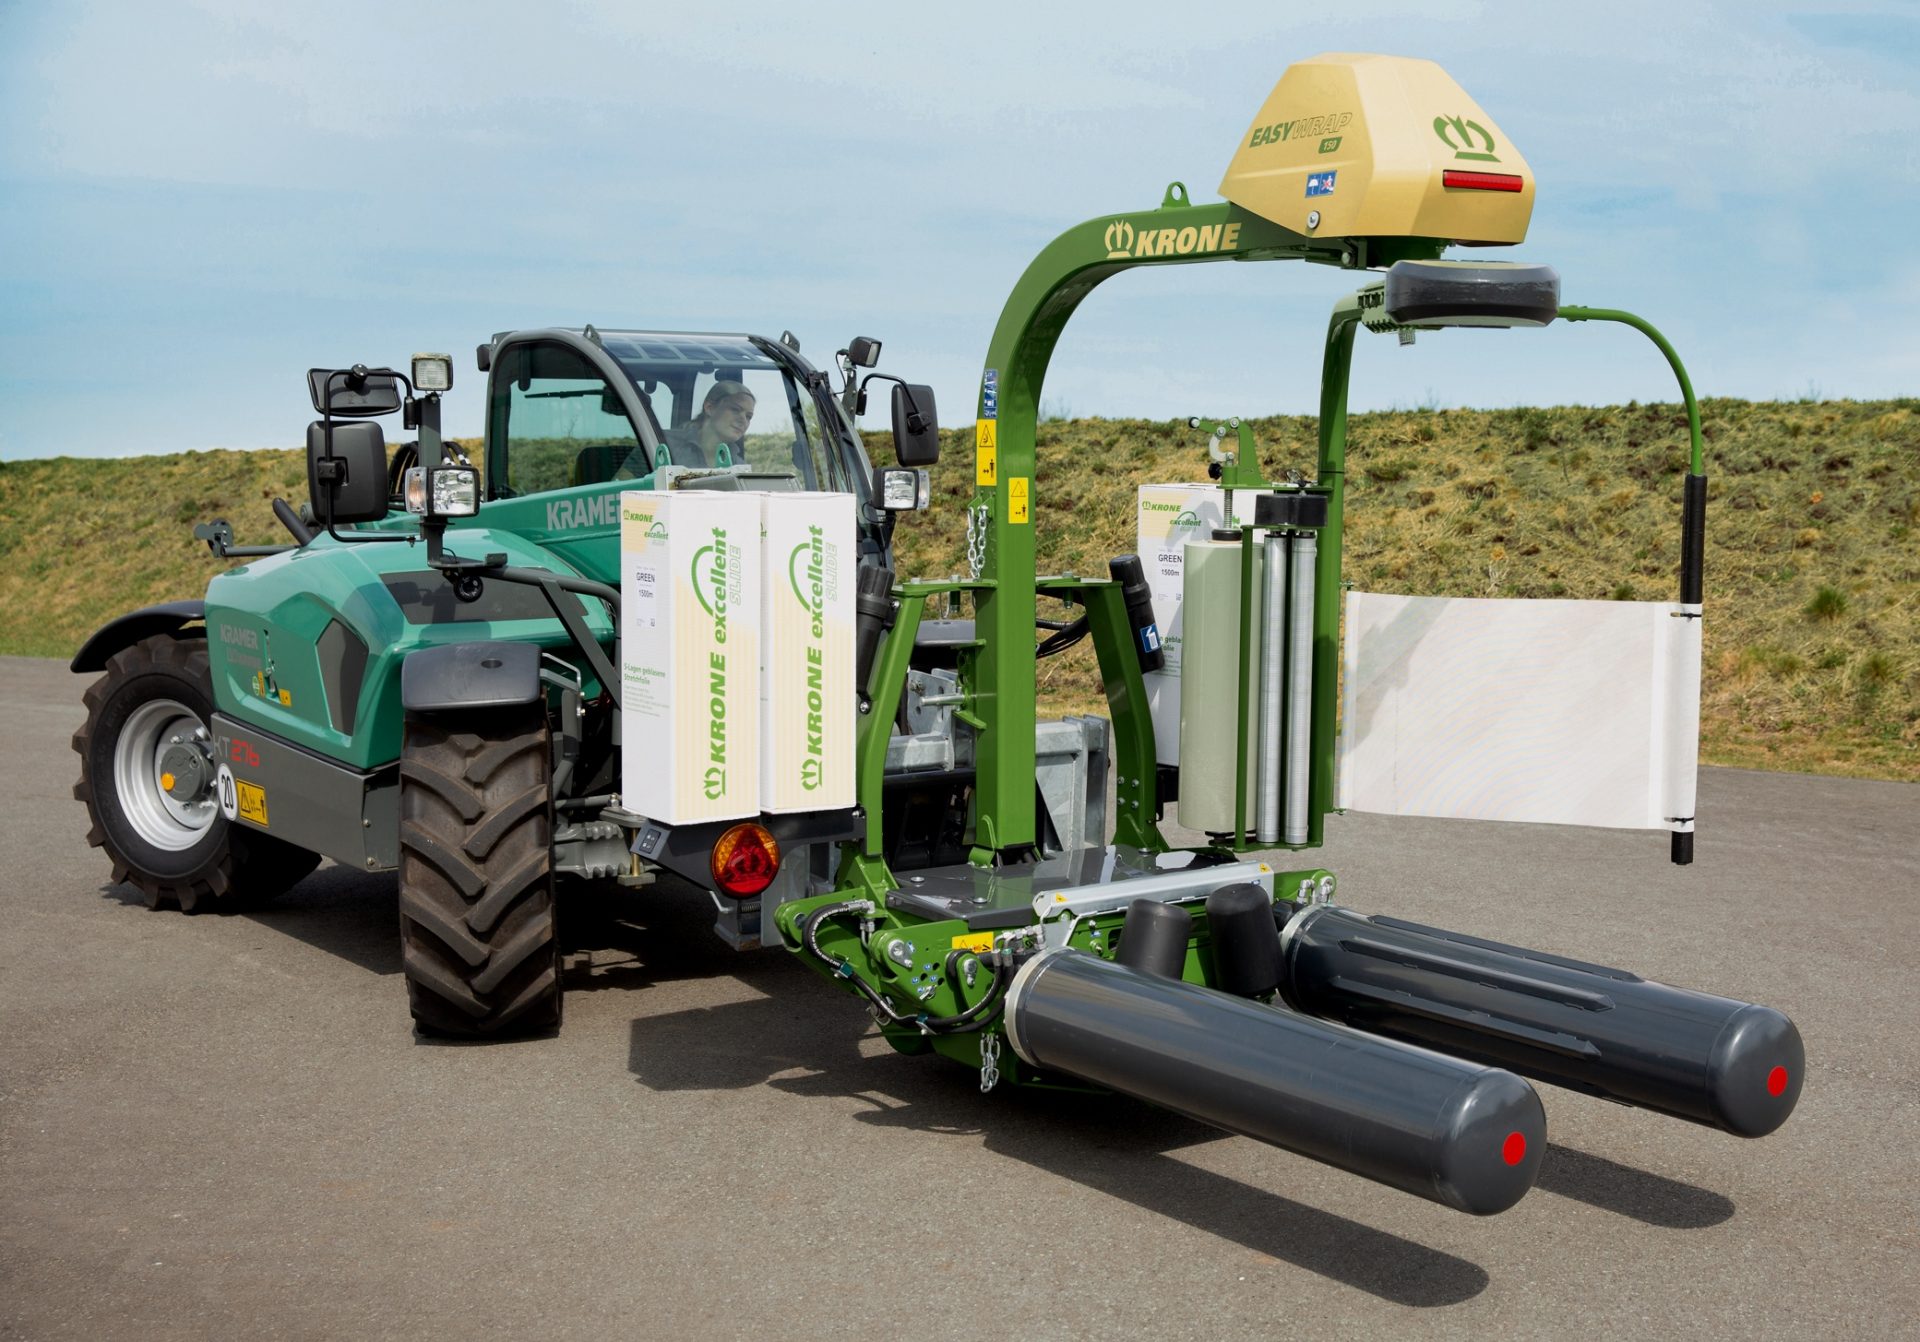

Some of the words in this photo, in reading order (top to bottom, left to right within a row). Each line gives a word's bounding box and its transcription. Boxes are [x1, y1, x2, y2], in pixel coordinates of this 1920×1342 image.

[1135, 223, 1242, 257] KRONE
[630, 513, 653, 523] KRONE
[1151, 504, 1181, 512] KRONE
[1169, 519, 1202, 527] excellent
[729, 545, 741, 605] SLIDE
[825, 542, 837, 602] SLIDE
[1158, 554, 1182, 563] GREEN
[1161, 568, 1180, 577] 1500m
[636, 572, 655, 582] GREEN
[710, 527, 726, 644] excellent
[807, 525, 823, 639] excellent
[221, 624, 258, 649] KRAMER
[710, 652, 726, 764] KRONE
[807, 646, 822, 756] KRONE
[221, 774, 234, 810] 20
